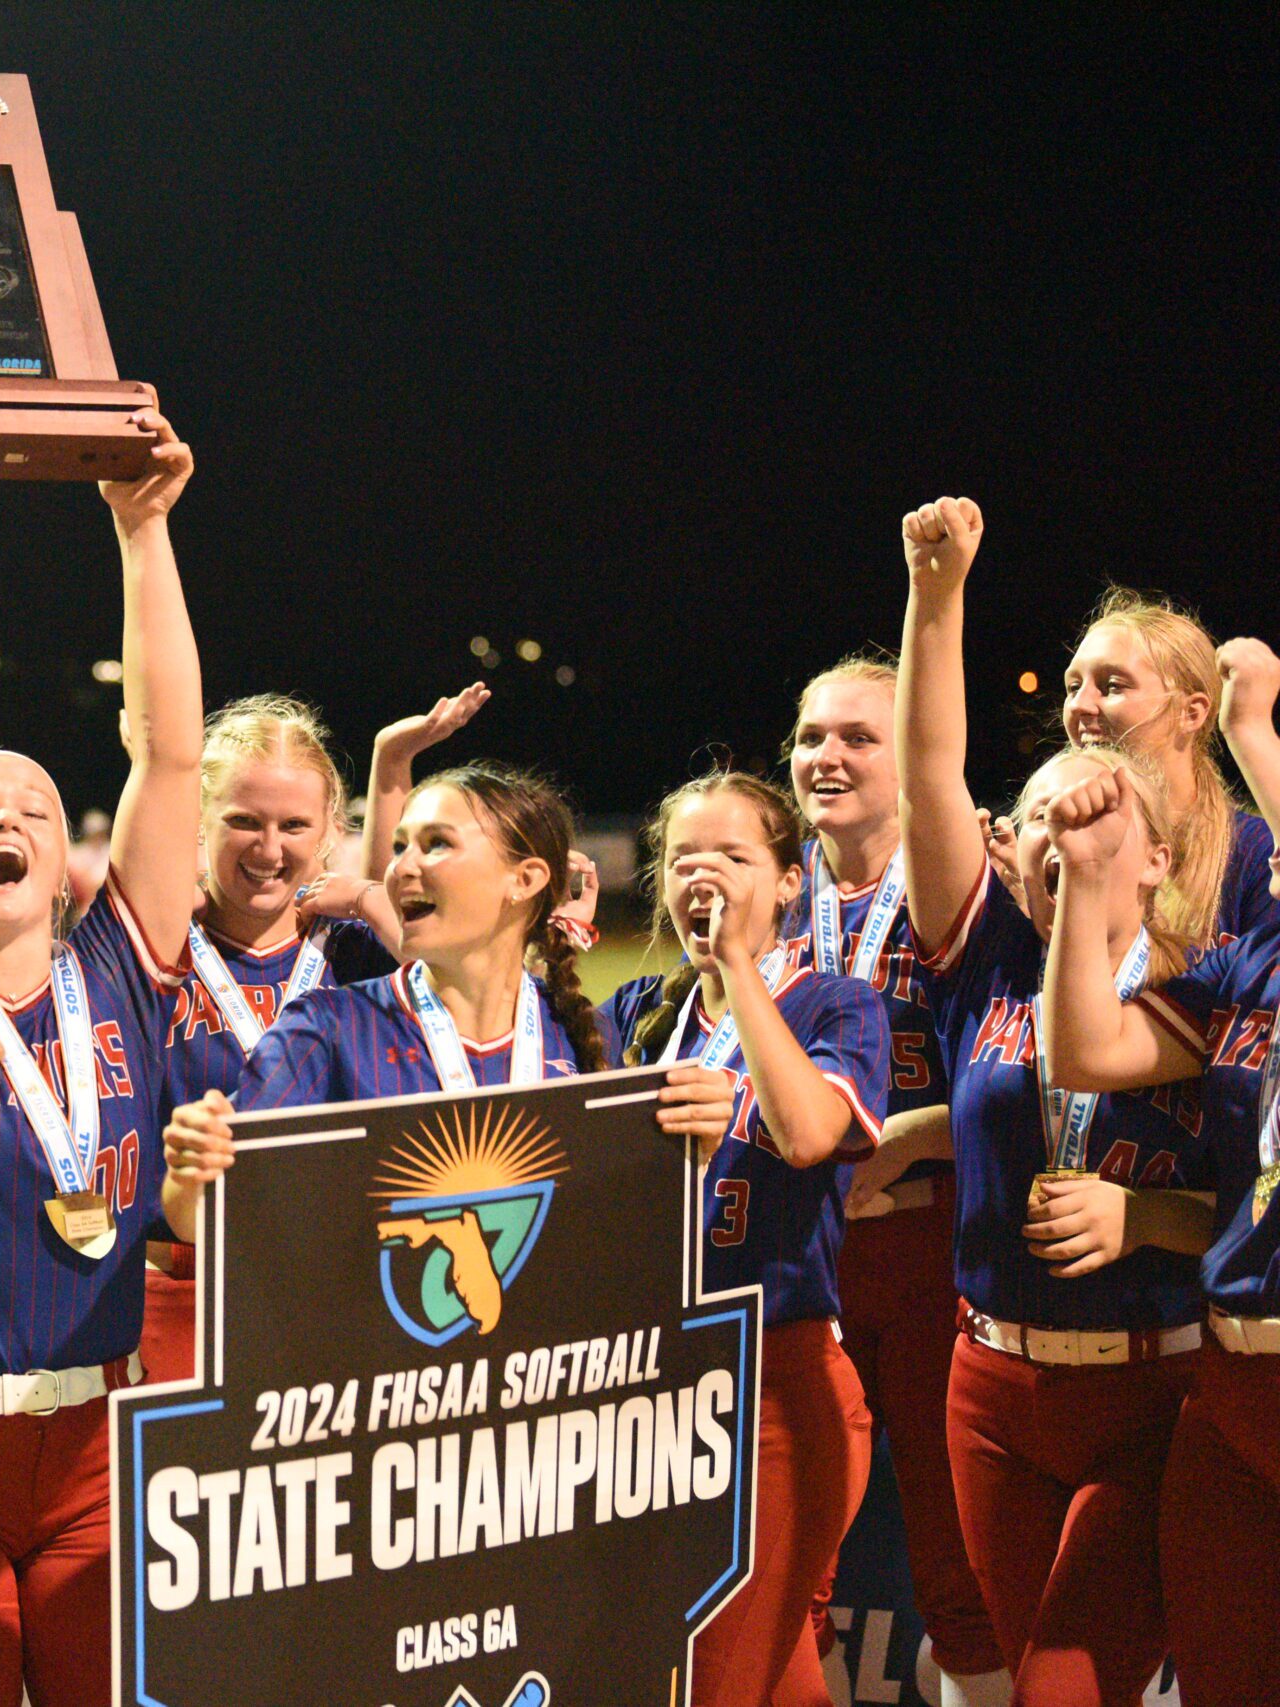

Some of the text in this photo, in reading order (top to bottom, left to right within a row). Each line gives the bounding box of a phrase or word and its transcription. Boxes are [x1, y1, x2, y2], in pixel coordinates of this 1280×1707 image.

[887, 1032, 931, 1090] 5
[711, 1178, 749, 1247] 3
[251, 1326, 661, 1451] 2024 FHSAA SOFTBALL
[147, 1368, 734, 1612] STATE CHAMPIONS
[396, 1604, 518, 1672] CLASS 6A
